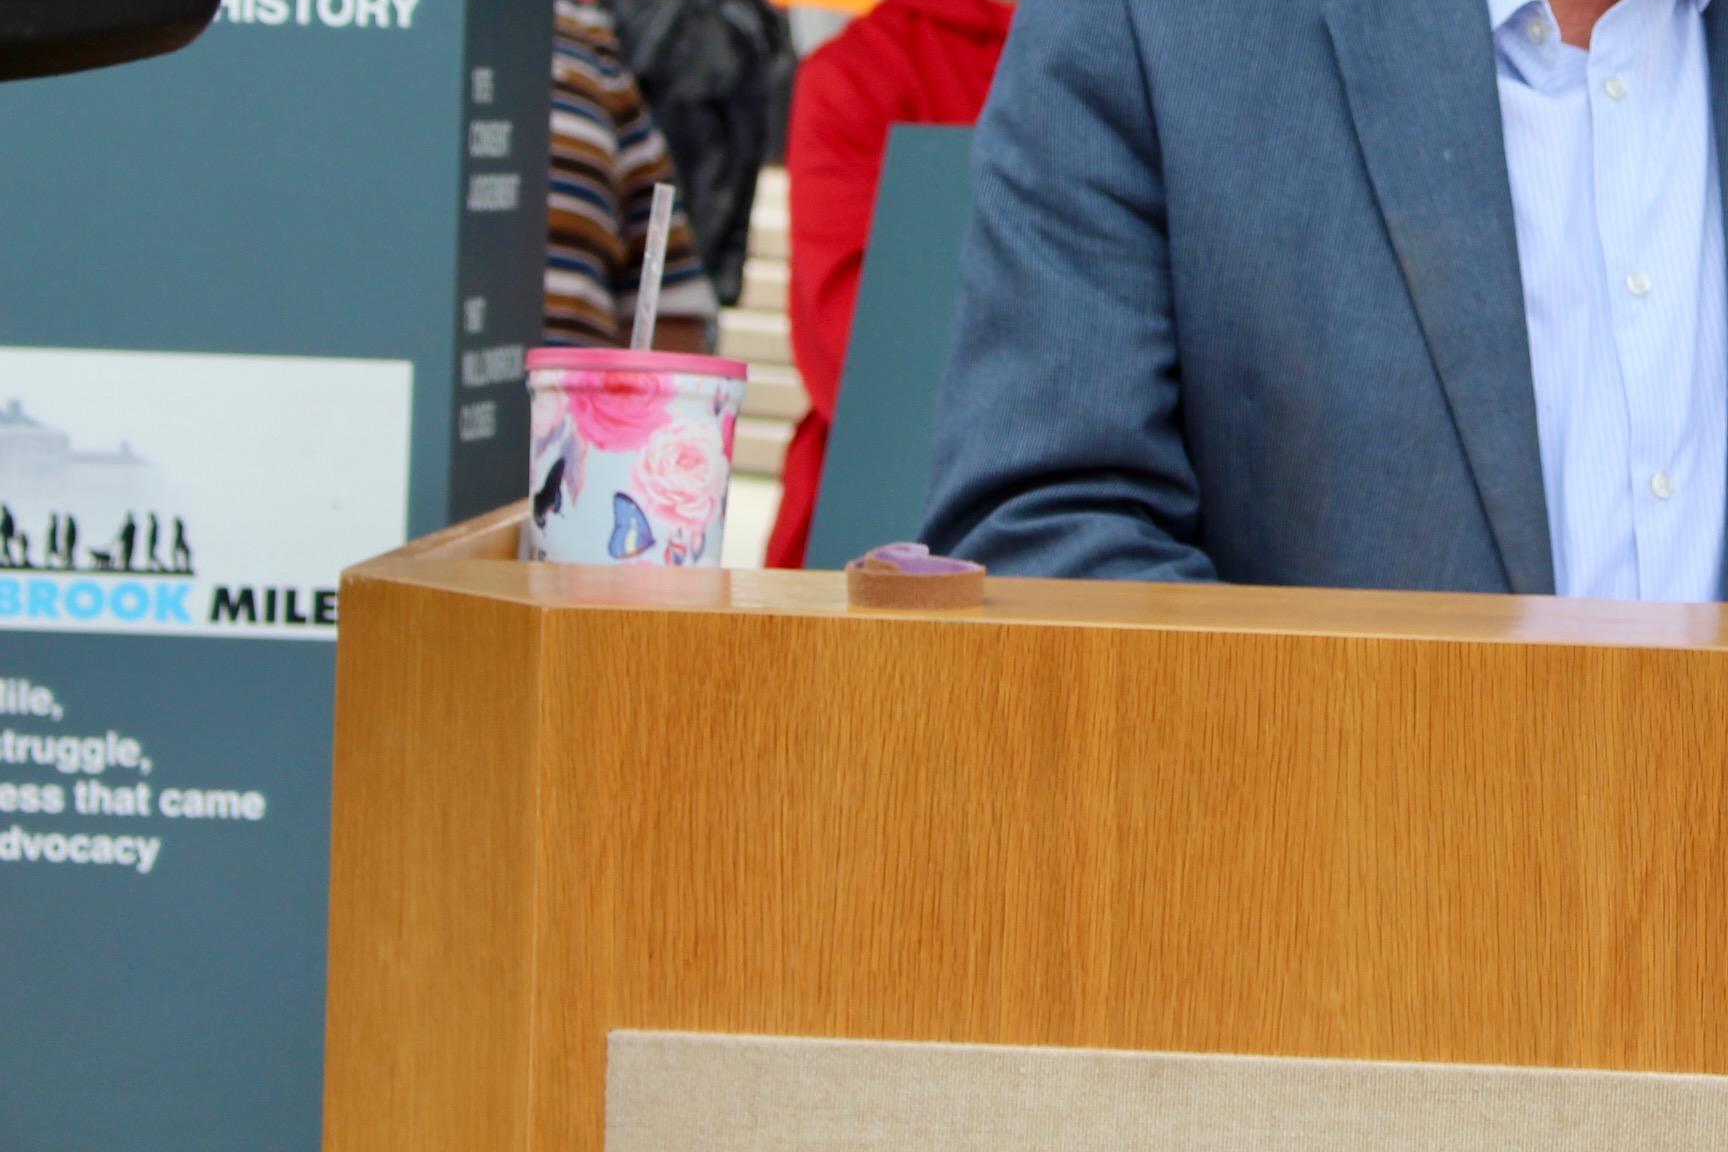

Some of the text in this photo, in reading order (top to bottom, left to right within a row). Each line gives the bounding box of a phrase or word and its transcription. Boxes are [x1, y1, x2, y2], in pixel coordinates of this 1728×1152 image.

[210, 586, 337, 625] MILE
[74, 779, 152, 817] that
[159, 788, 266, 822] came
